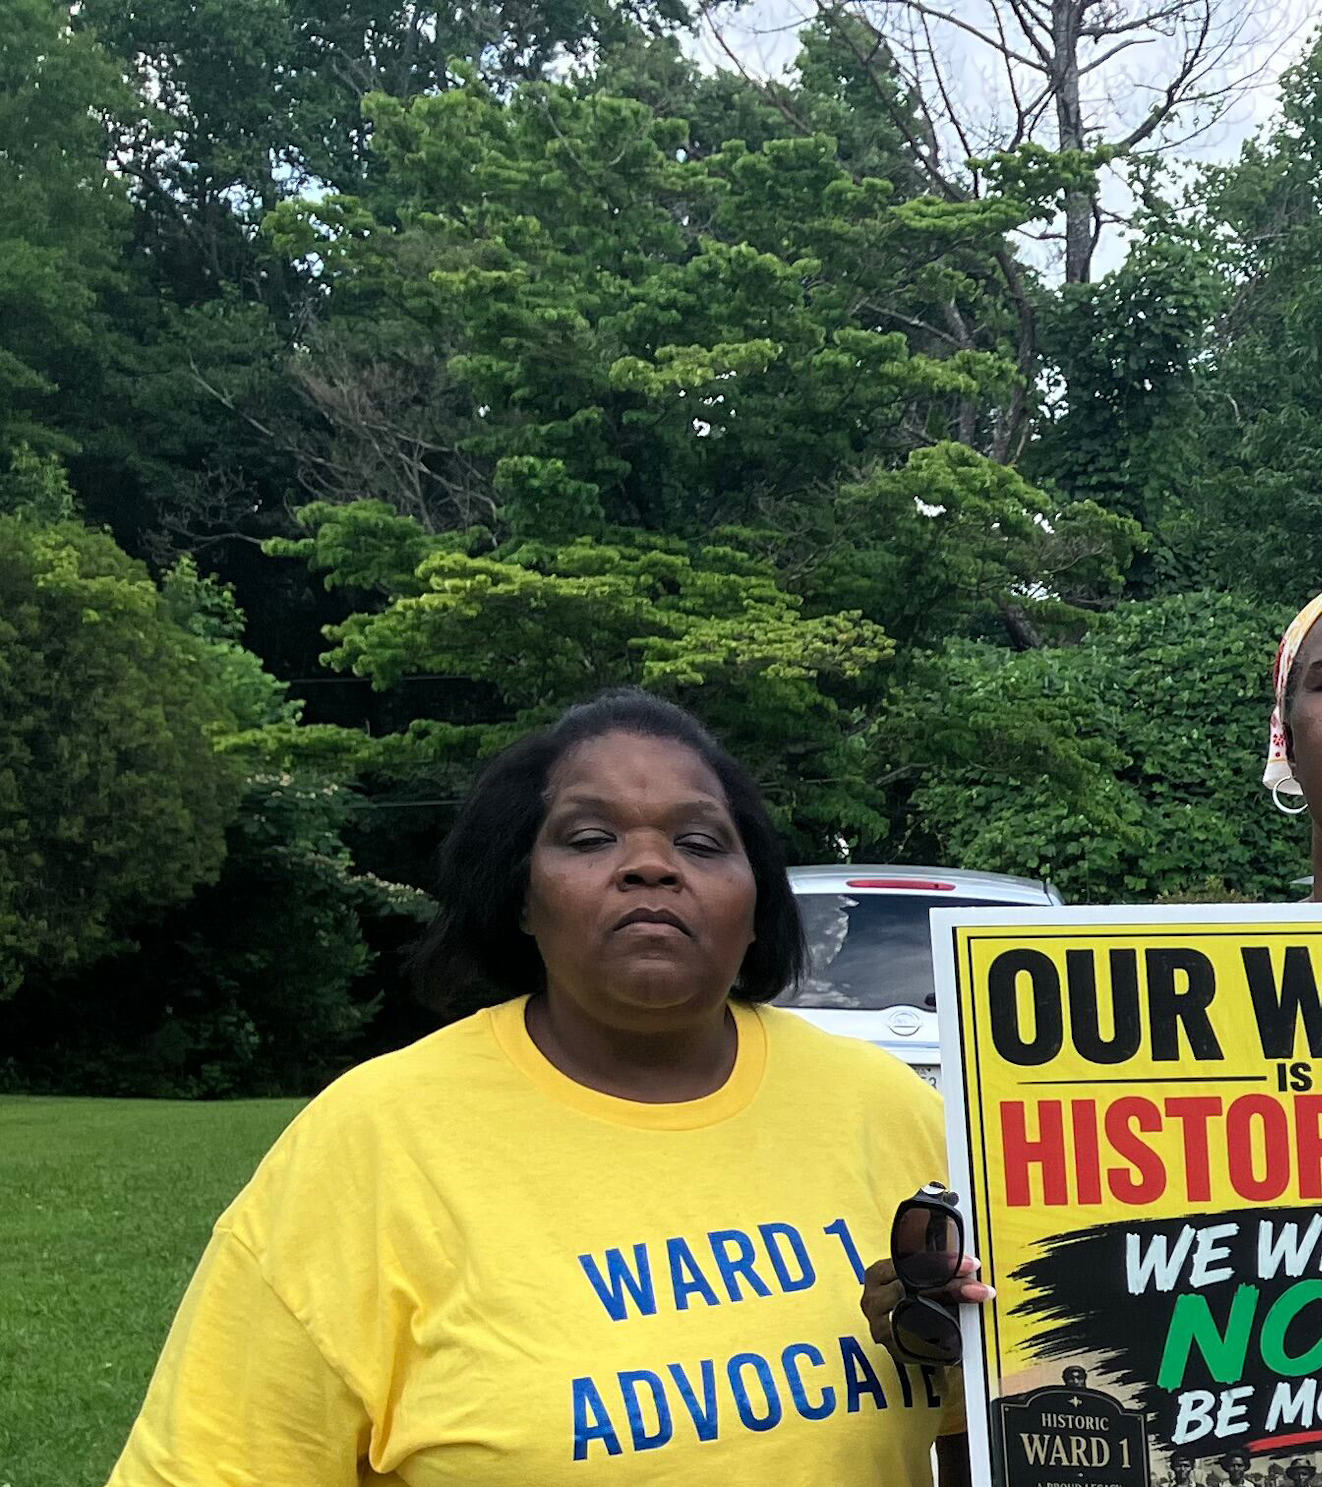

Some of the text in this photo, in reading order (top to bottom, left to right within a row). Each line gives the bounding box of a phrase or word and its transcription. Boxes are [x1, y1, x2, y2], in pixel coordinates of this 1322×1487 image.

[988, 947, 1225, 1066] OUR
[1277, 1063, 1313, 1093] IS
[577, 1218, 865, 1322] WARD 1
[1125, 1222, 1239, 1295] WE
[1041, 1413, 1110, 1431] HISTORIC
[1171, 1385, 1255, 1445] BE
[1020, 1433, 1131, 1468] WARD 1
